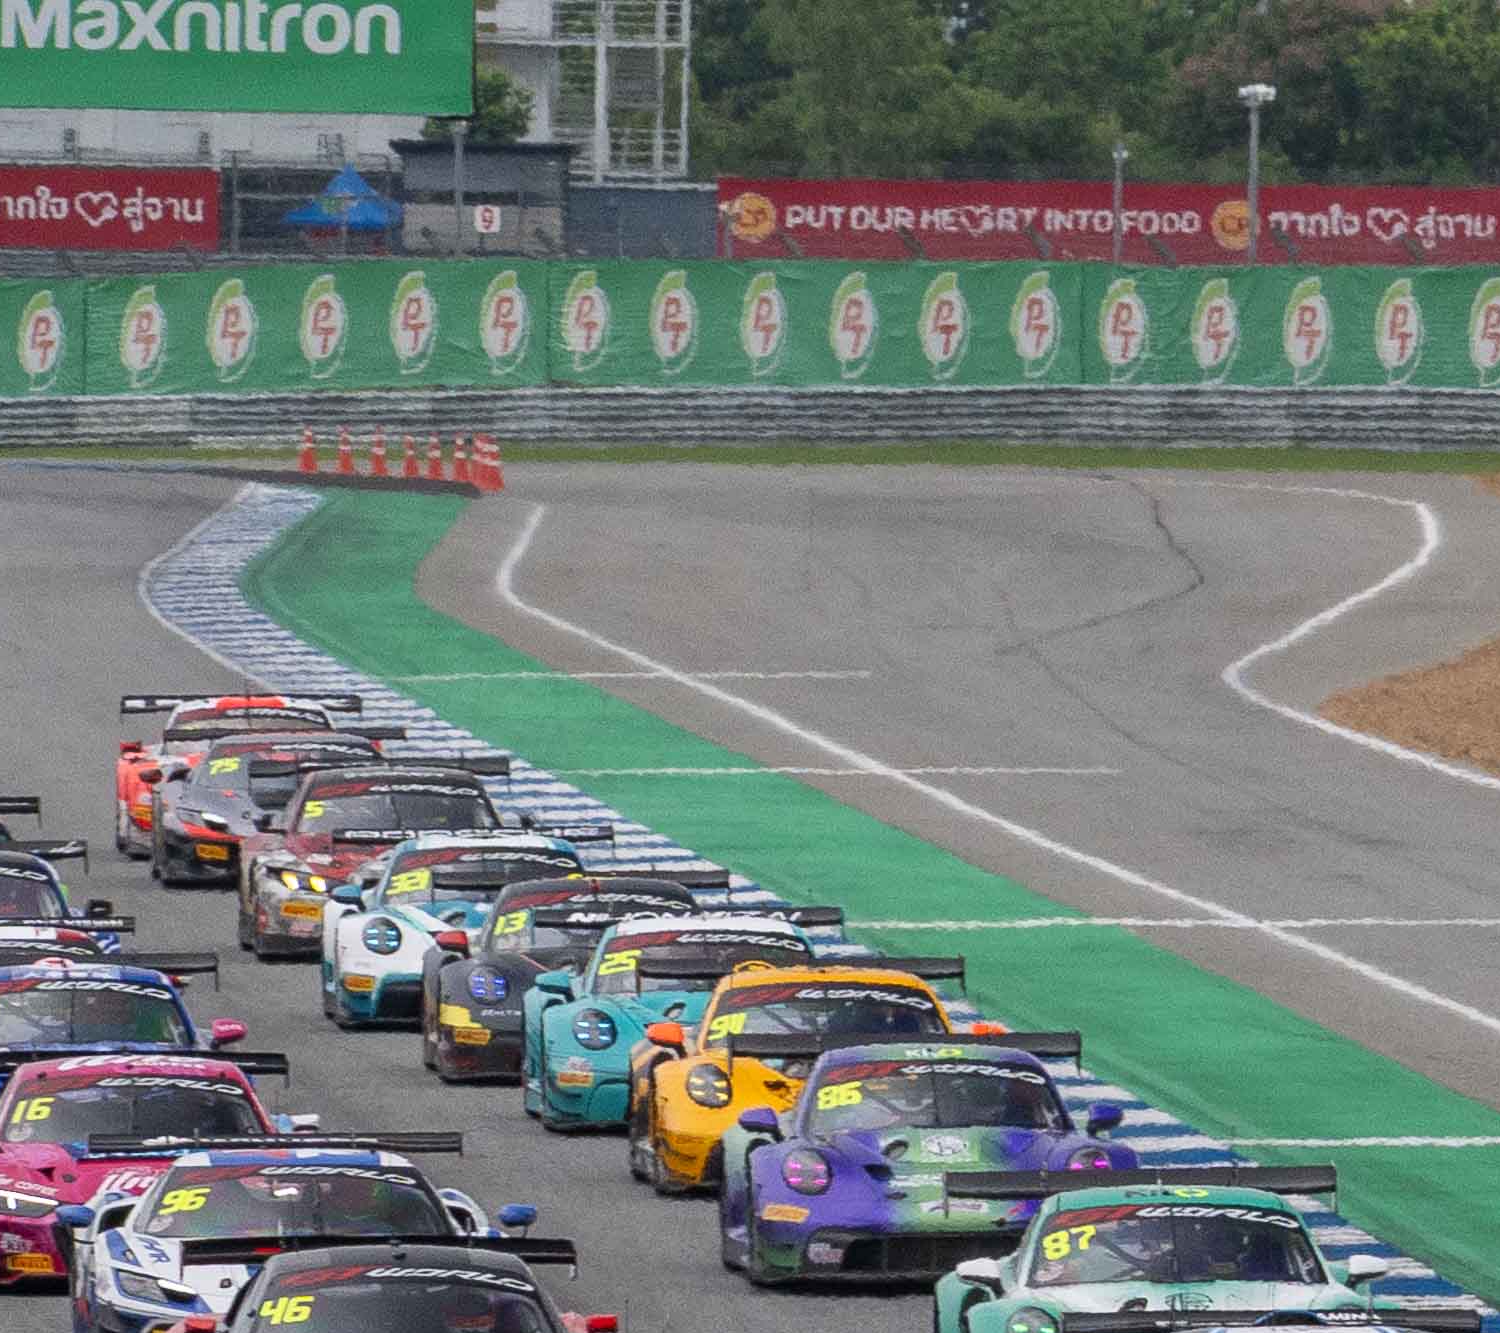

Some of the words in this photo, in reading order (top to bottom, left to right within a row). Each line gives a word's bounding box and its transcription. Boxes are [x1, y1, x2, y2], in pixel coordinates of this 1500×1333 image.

[785, 205, 841, 229] PUT
[1043, 208, 1115, 232] INTO
[1121, 210, 1201, 235] FOOD
[34, 981, 173, 1000] WORLD
[96, 1077, 245, 1096] WORLD
[9, 1097, 55, 1125] 16
[260, 1164, 417, 1187] WORLD
[158, 1187, 212, 1216] 96
[1134, 1205, 1300, 1230] WORLD
[1041, 1224, 1097, 1262] 87
[364, 1264, 534, 1293] WORLD
[258, 1295, 315, 1326] 46
